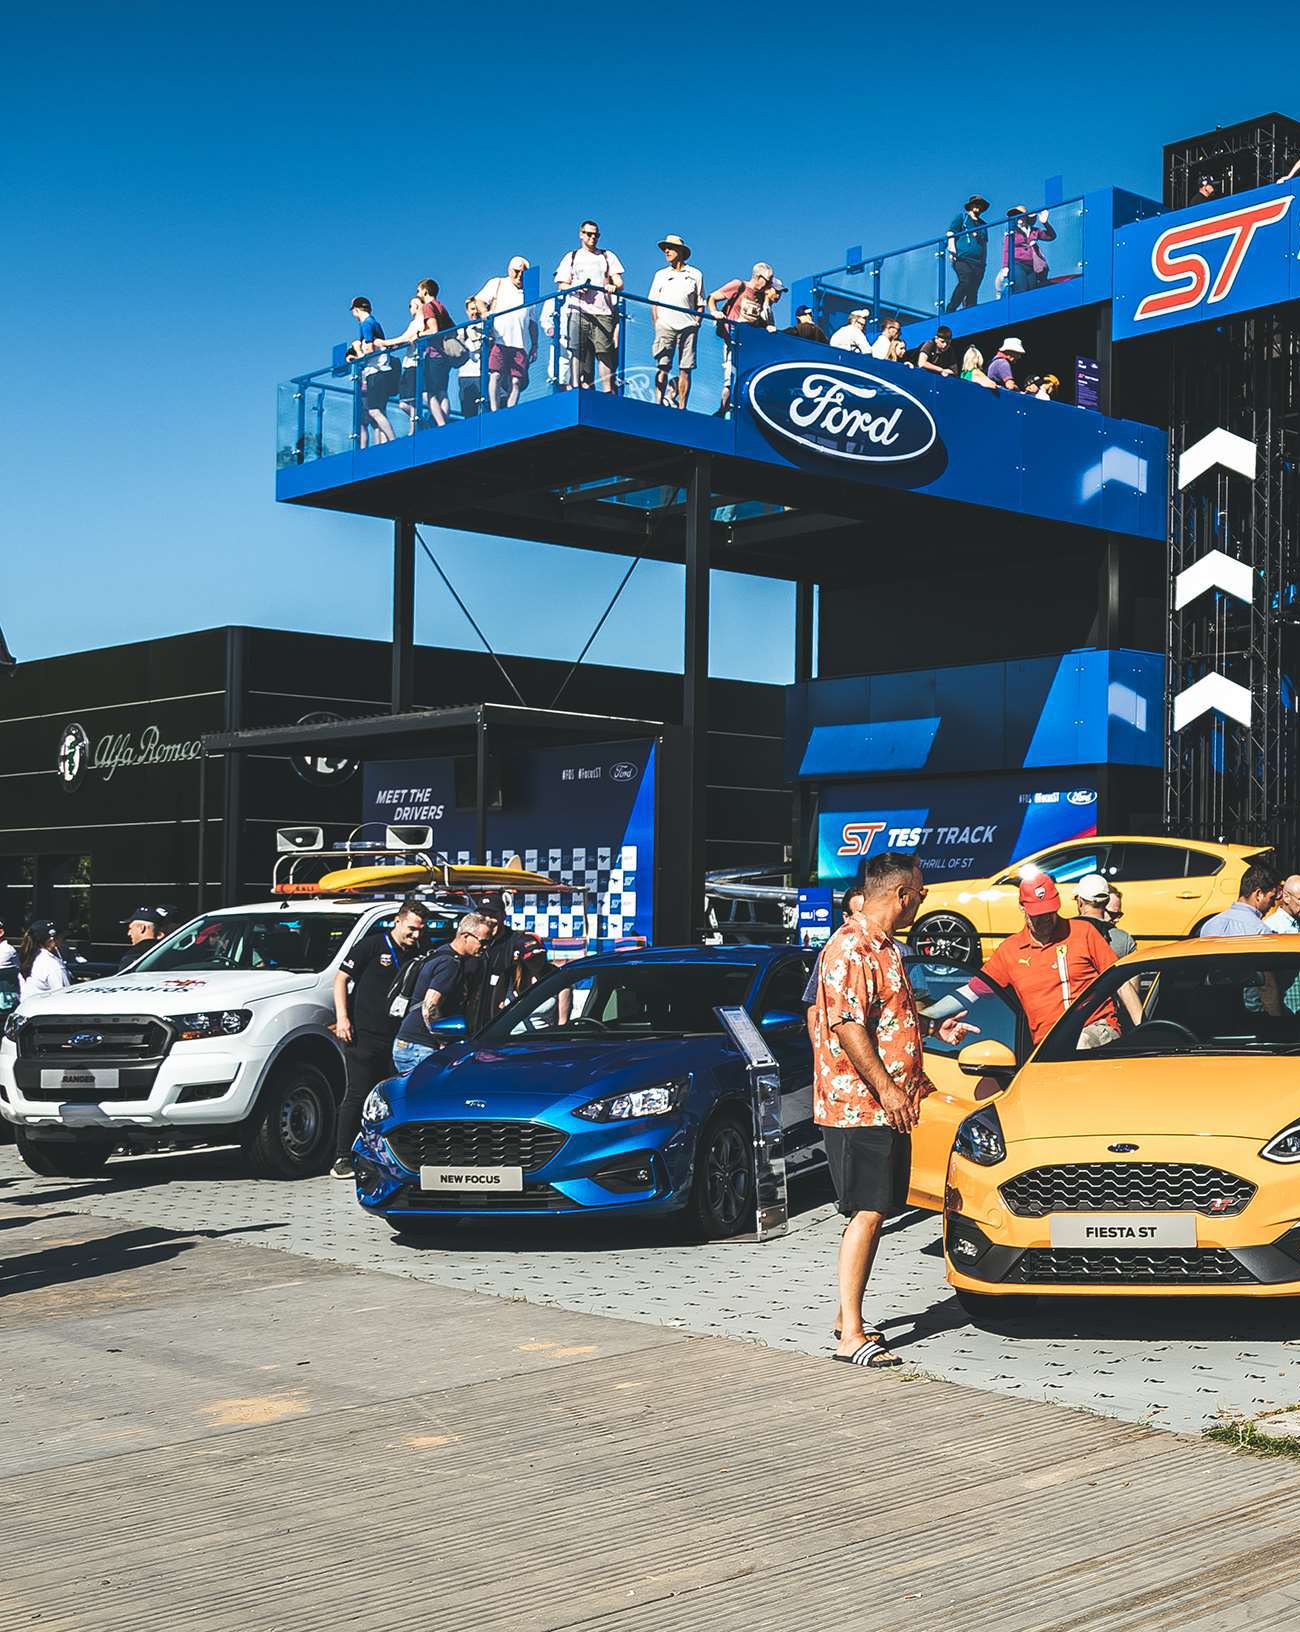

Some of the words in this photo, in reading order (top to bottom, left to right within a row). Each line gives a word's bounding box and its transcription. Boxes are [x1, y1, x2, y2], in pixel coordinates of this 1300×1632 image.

[1134, 195, 1294, 321] ST
[789, 373, 902, 446] Ford
[95, 732, 138, 781] Alfa
[138, 725, 201, 763] Romeo
[375, 789, 408, 804] MEET
[410, 788, 432, 803] THE
[394, 805, 444, 821] DRIVERS
[837, 822, 887, 855] ST
[887, 827, 933, 848] TEST
[936, 825, 997, 845] TRACK
[919, 858, 946, 869] THRILL
[948, 858, 961, 868] OF
[962, 857, 974, 868] ST
[62, 1075, 96, 1083] RANGER
[440, 1174, 463, 1184] NEW
[465, 1175, 501, 1184] FOCUS
[1085, 1226, 1135, 1238] FIESTA
[1138, 1226, 1158, 1238] ST
